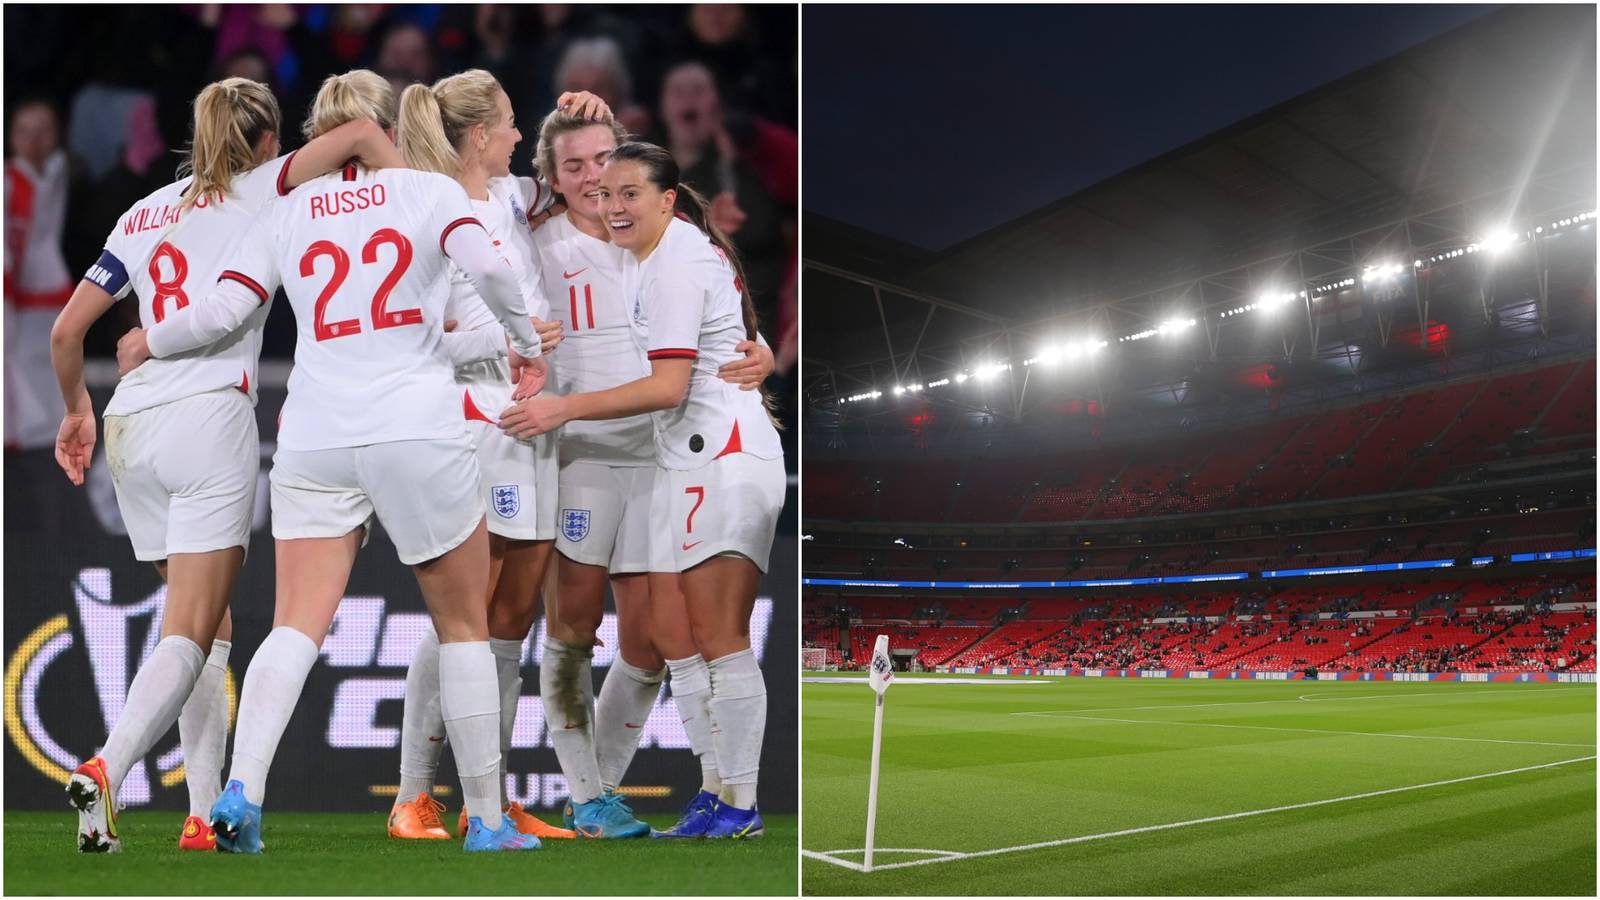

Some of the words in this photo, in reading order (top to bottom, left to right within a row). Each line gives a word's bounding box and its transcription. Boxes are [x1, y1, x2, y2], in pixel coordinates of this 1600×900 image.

[310, 184, 385, 219] RUSSO
[148, 240, 190, 324] 8
[299, 227, 423, 342] 22
[569, 283, 595, 332] 11
[685, 486, 705, 534] 7
[504, 772, 571, 807] UP
